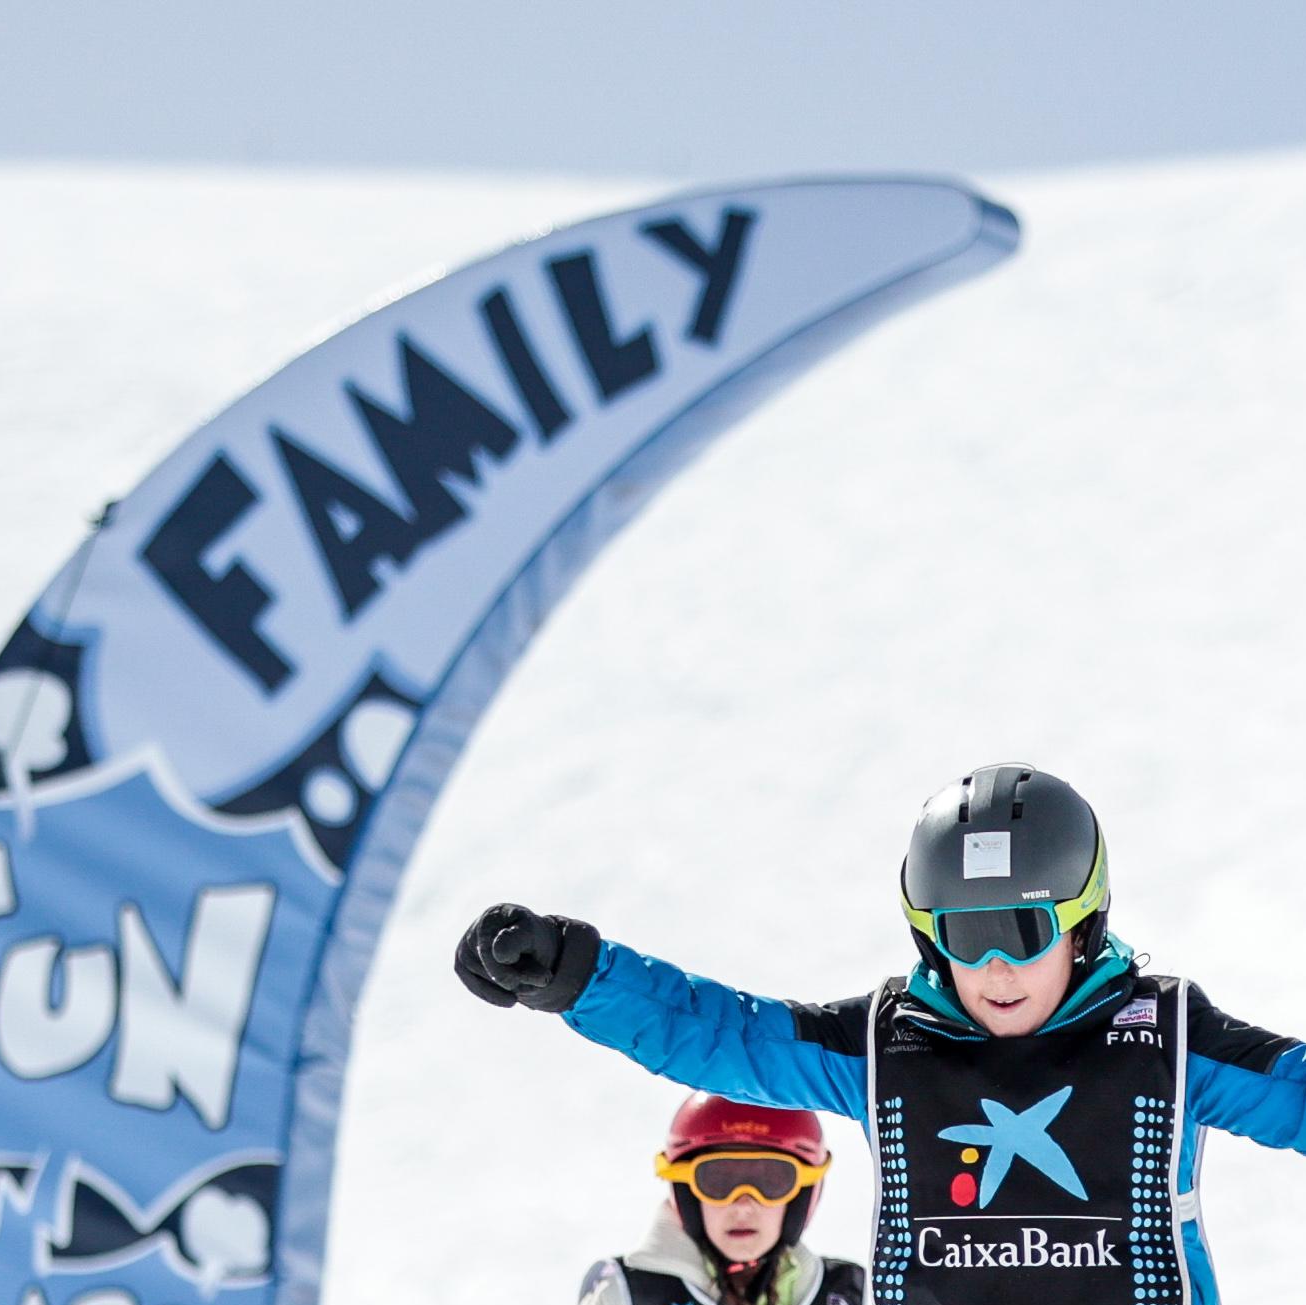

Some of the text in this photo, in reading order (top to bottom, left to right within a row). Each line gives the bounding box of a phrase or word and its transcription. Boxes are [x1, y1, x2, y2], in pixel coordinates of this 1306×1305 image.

[140, 208, 758, 699] FAMILY
[1107, 1030, 1163, 1049] FADI
[918, 1226, 1122, 1267] CaixaBank
